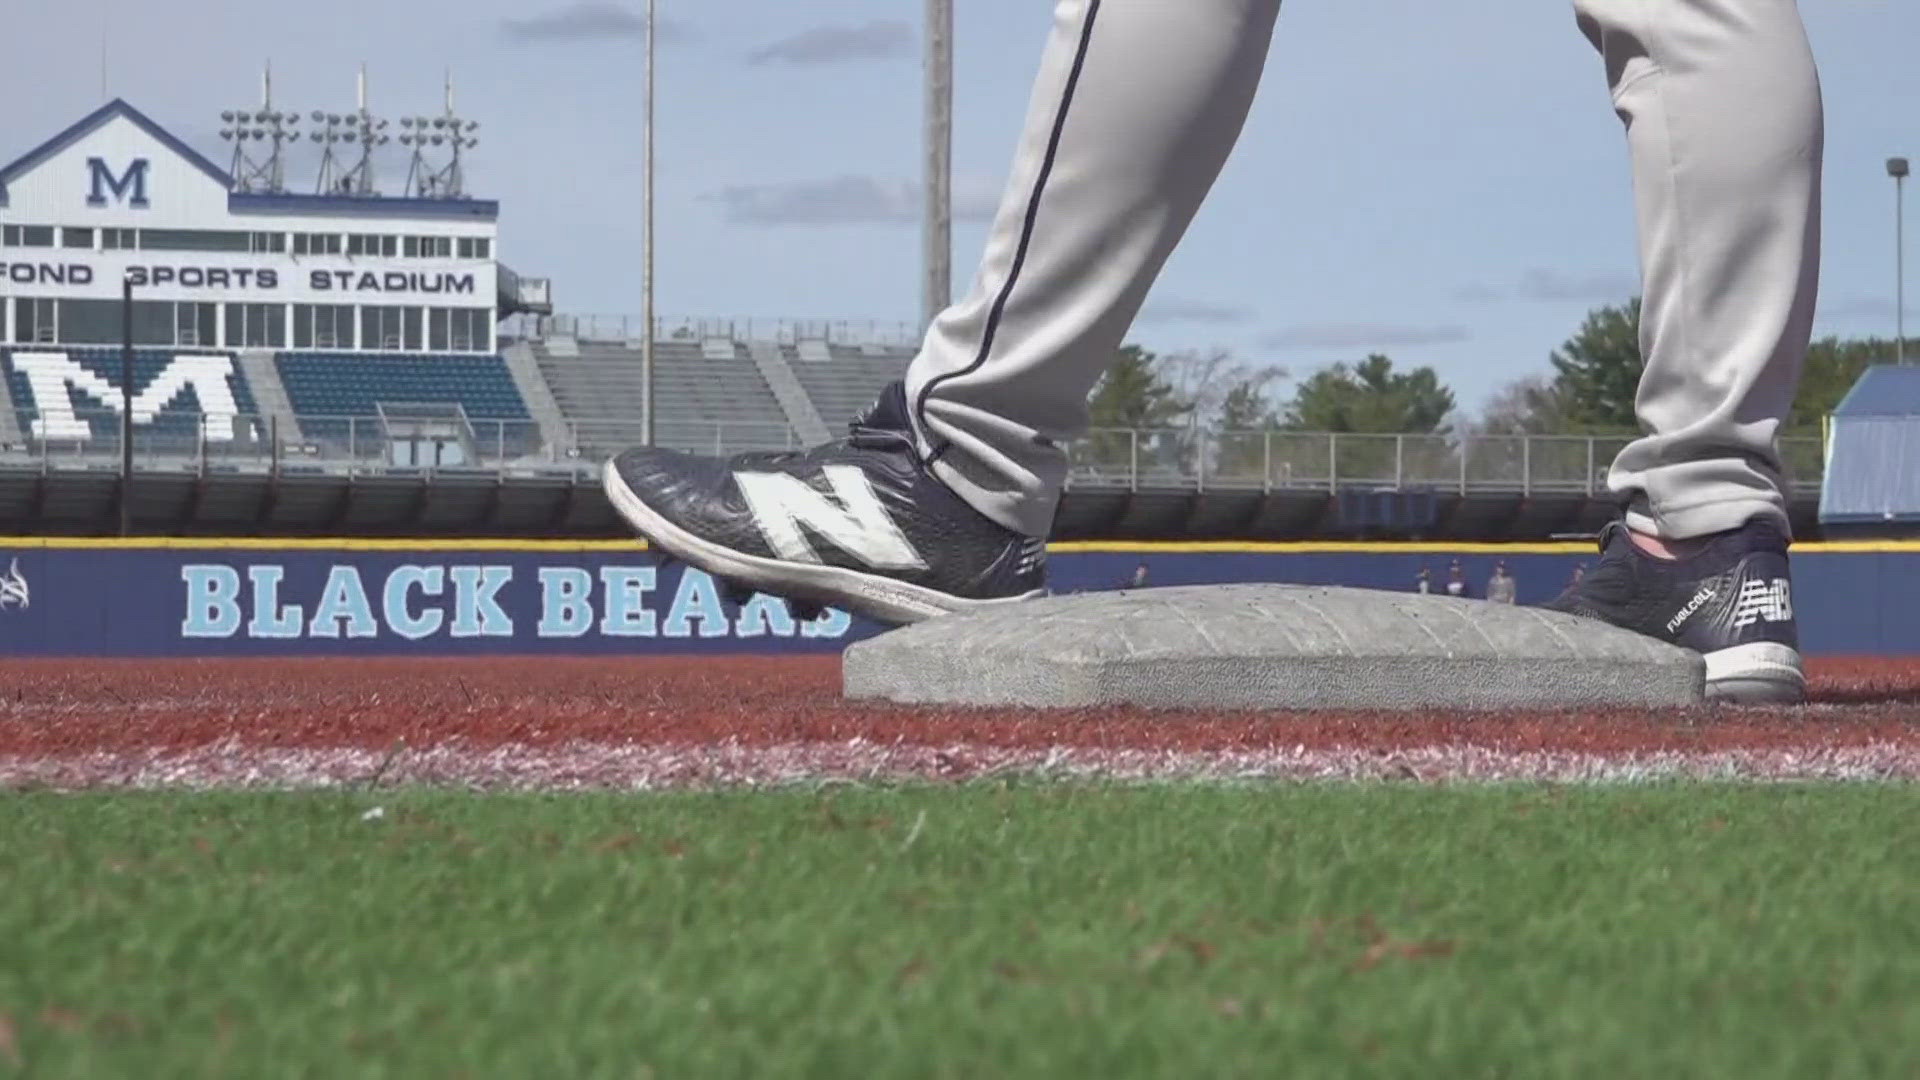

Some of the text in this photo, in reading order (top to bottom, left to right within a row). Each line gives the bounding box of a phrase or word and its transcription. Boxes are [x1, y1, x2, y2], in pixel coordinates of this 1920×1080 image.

[86, 157, 149, 207] M
[125, 265, 279, 289] SPORTS
[310, 270, 474, 294] STADIUM
[11, 352, 260, 442] M
[181, 565, 513, 639] BLACK
